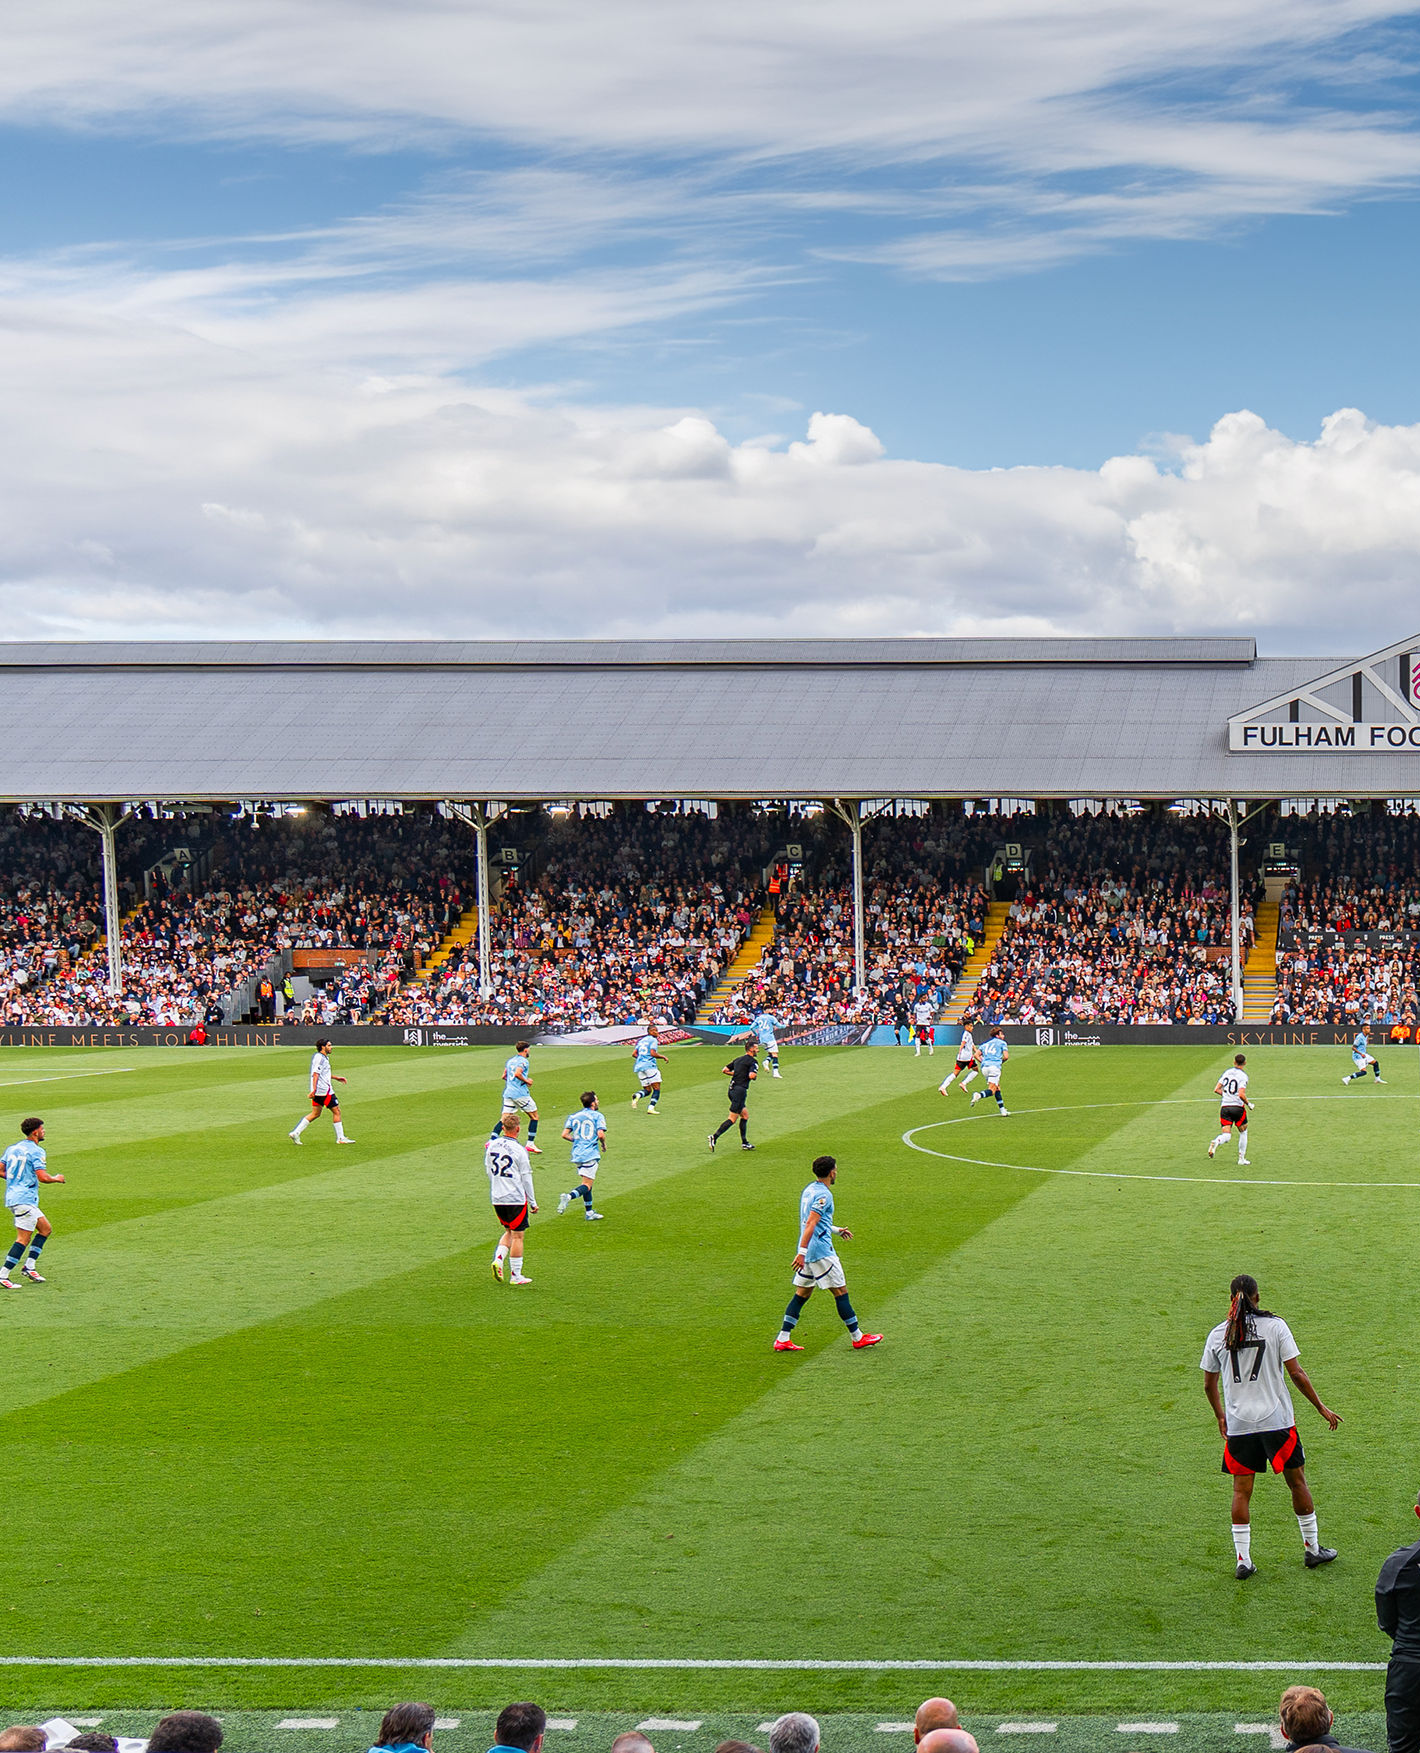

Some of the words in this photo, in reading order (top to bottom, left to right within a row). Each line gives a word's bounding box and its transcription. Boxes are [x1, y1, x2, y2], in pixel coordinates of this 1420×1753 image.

[1243, 726, 1355, 746] FULHAM
[179, 850, 190, 860] A
[504, 851, 514, 860] B
[790, 846, 799, 856] C
[1009, 846, 1019, 856] D
[1273, 846, 1281, 855] E
[758, 1020, 770, 1031] 24
[72, 1034, 138, 1046] MEETS
[433, 1031, 446, 1040] the
[1064, 1031, 1078, 1040] the
[1227, 1033, 1318, 1045] SKYLINE
[984, 1043, 996, 1055] 14
[1222, 1077, 1238, 1095] 20
[572, 1118, 594, 1140] 20
[7, 1155, 27, 1180] 27
[490, 1152, 513, 1178] 32
[1230, 1339, 1266, 1383] 17
